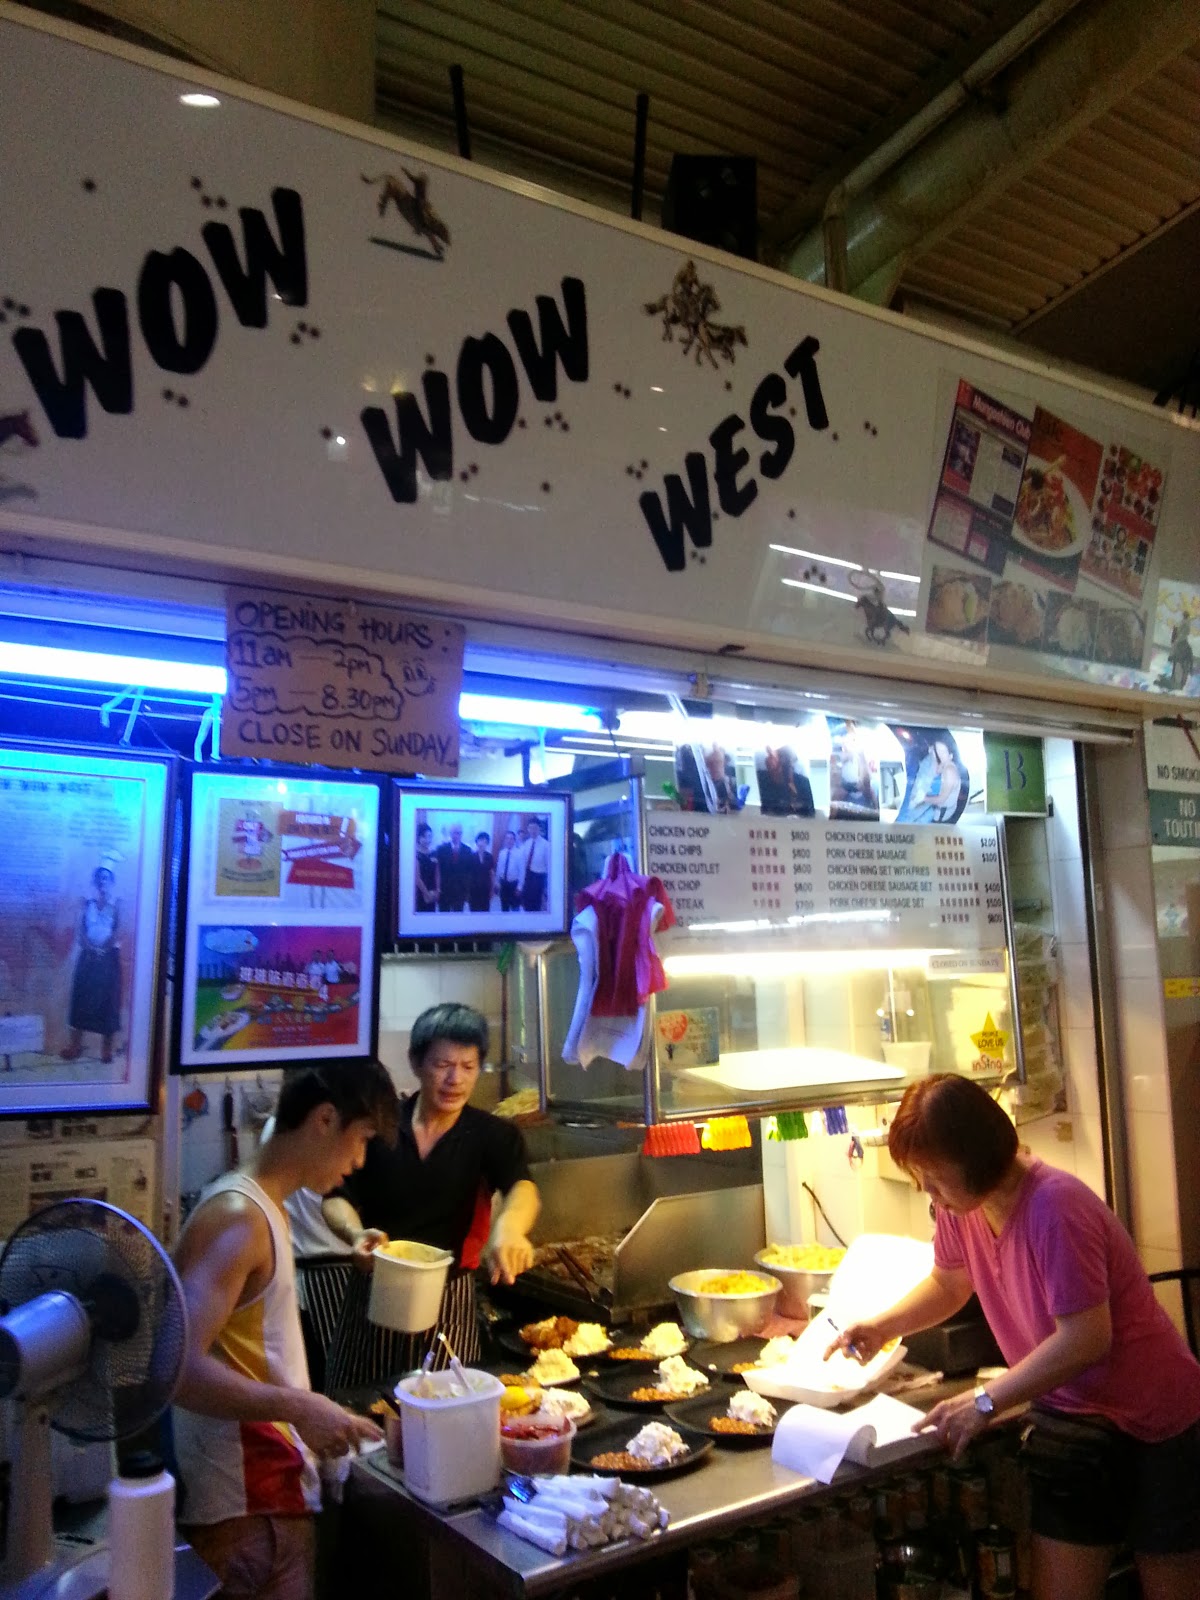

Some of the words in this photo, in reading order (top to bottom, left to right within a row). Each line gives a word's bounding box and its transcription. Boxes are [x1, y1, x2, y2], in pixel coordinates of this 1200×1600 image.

[12, 187, 308, 439] WOW
[360, 276, 589, 503] WOW
[638, 335, 829, 572] WEST
[234, 601, 345, 634] OPENING
[238, 720, 321, 750] CLOSE
[330, 729, 362, 753] ON
[1157, 764, 1170, 779] NO
[1179, 798, 1197, 818] NO
